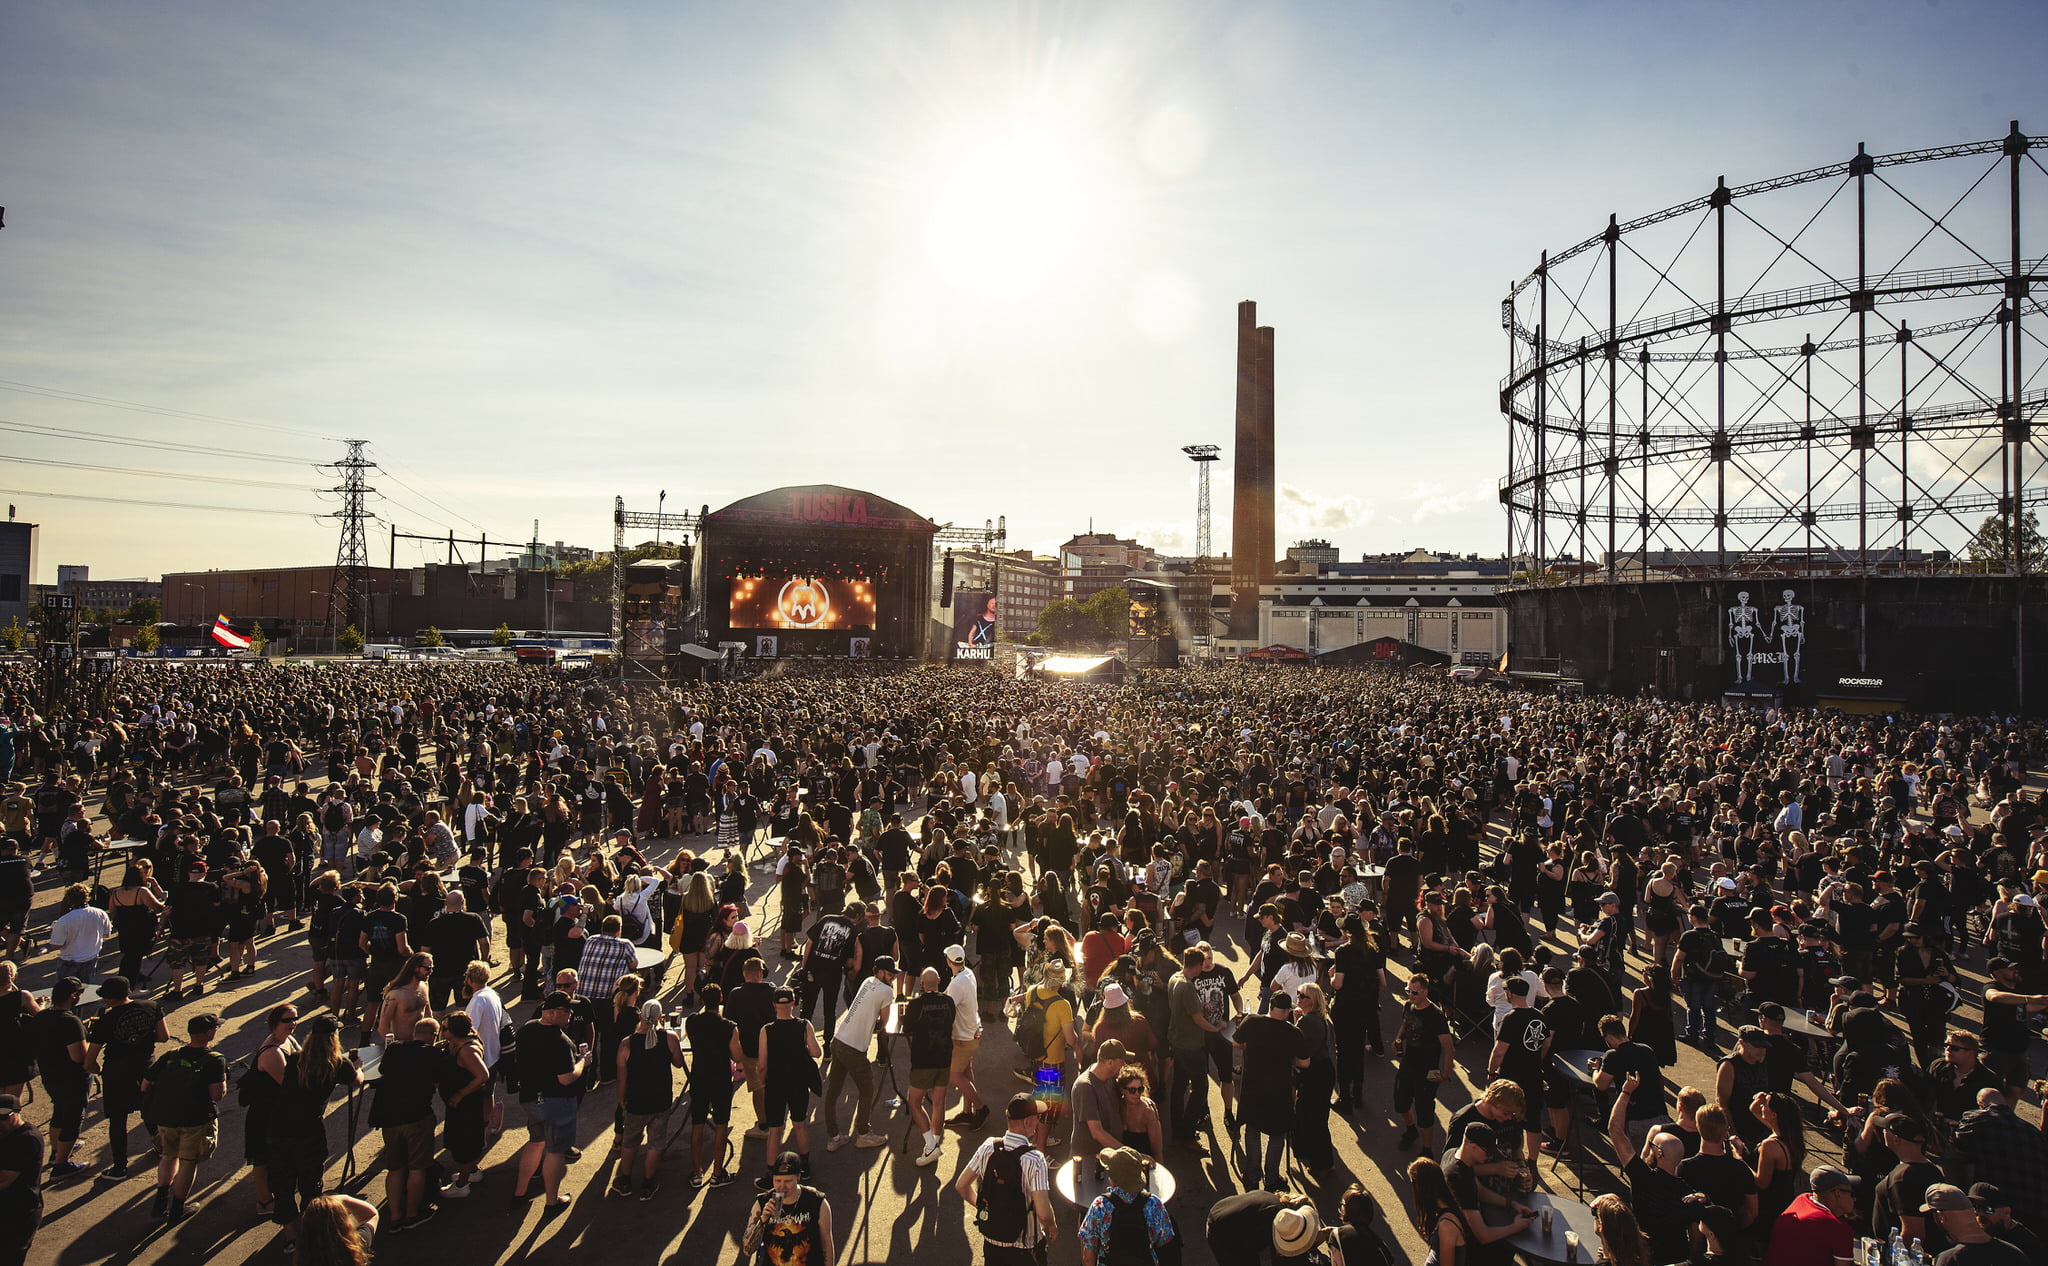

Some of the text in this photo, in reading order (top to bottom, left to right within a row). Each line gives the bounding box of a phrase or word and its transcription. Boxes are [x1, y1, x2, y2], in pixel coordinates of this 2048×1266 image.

[789, 492, 867, 523] TUSKA
[48, 597, 57, 607] E1
[62, 597, 73, 608] E1
[957, 648, 990, 659] KARHU
[1838, 677, 1883, 686] ROCKSTAR
